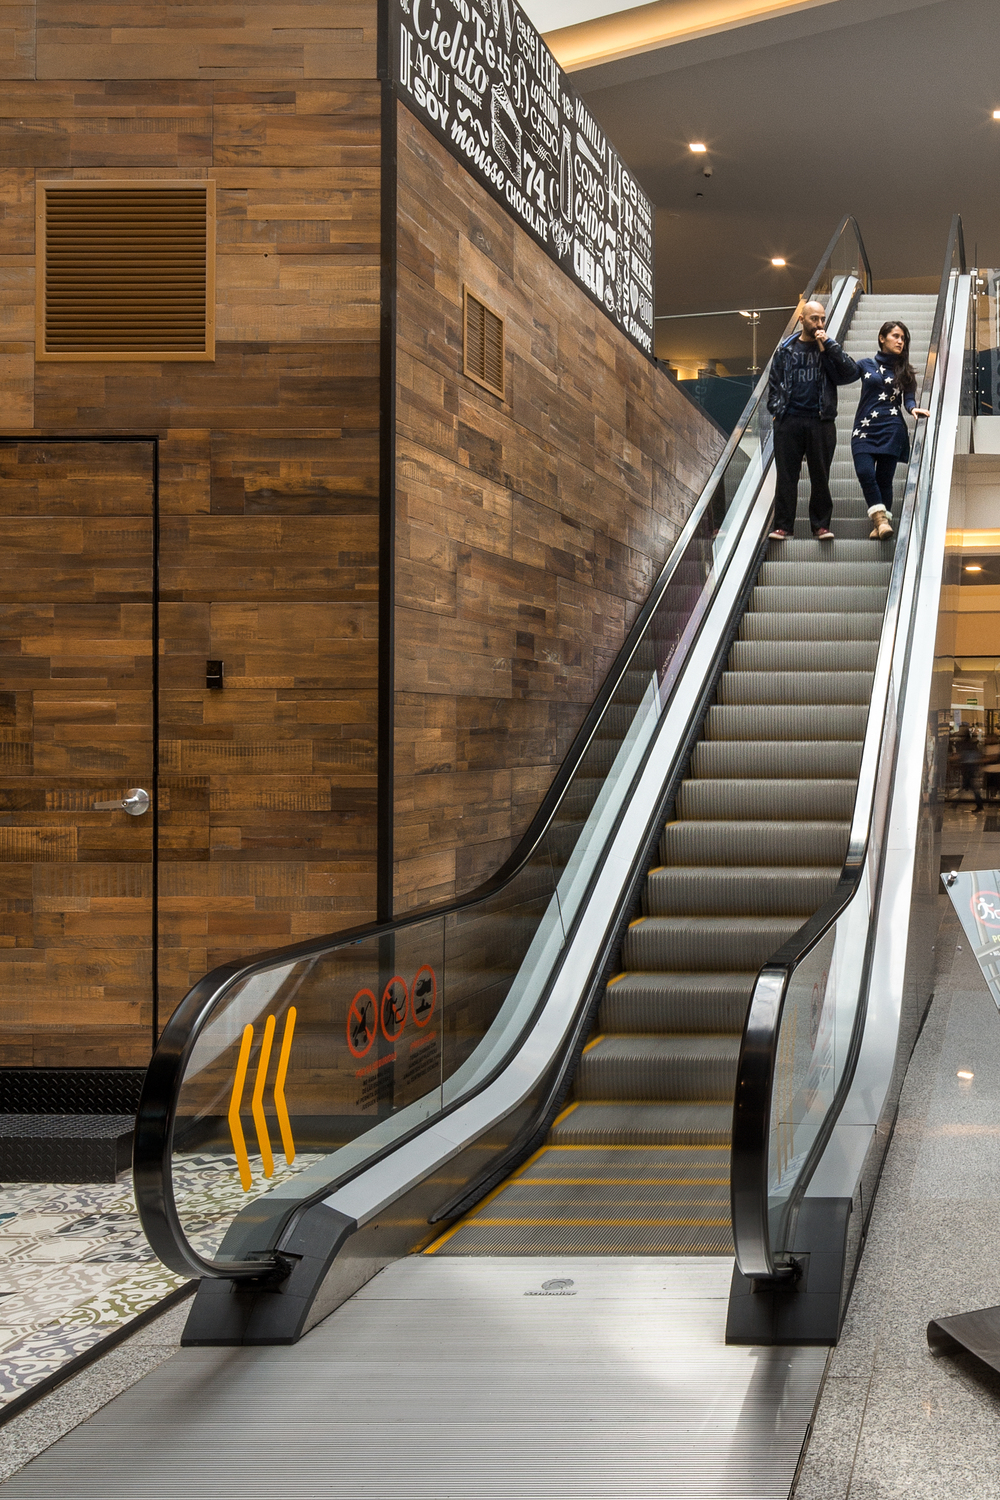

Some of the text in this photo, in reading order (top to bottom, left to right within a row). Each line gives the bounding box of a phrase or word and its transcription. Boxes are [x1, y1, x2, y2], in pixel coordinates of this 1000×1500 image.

[400, 22, 413, 95] DE
[471, 6, 496, 69] Té
[516, 15, 535, 51] café
[413, 42, 450, 107] AQUÍ
[497, 45, 511, 87] 15
[516, 34, 560, 107] CON LECHE
[413, 76, 450, 131] SOY
[575, 97, 606, 163] VAINILLA
[451, 119, 505, 191] mousse
[523, 148, 546, 213] 74
[574, 154, 605, 211] COMO
[505, 179, 548, 242] CHOCOLATE
[621, 170, 637, 207] 68
[574, 191, 604, 249] CAÍDO
[634, 214, 652, 249] CHOCO
[573, 238, 604, 302] CIELO
[631, 251, 652, 295] MIEL
[792, 351, 820, 365] STAY
